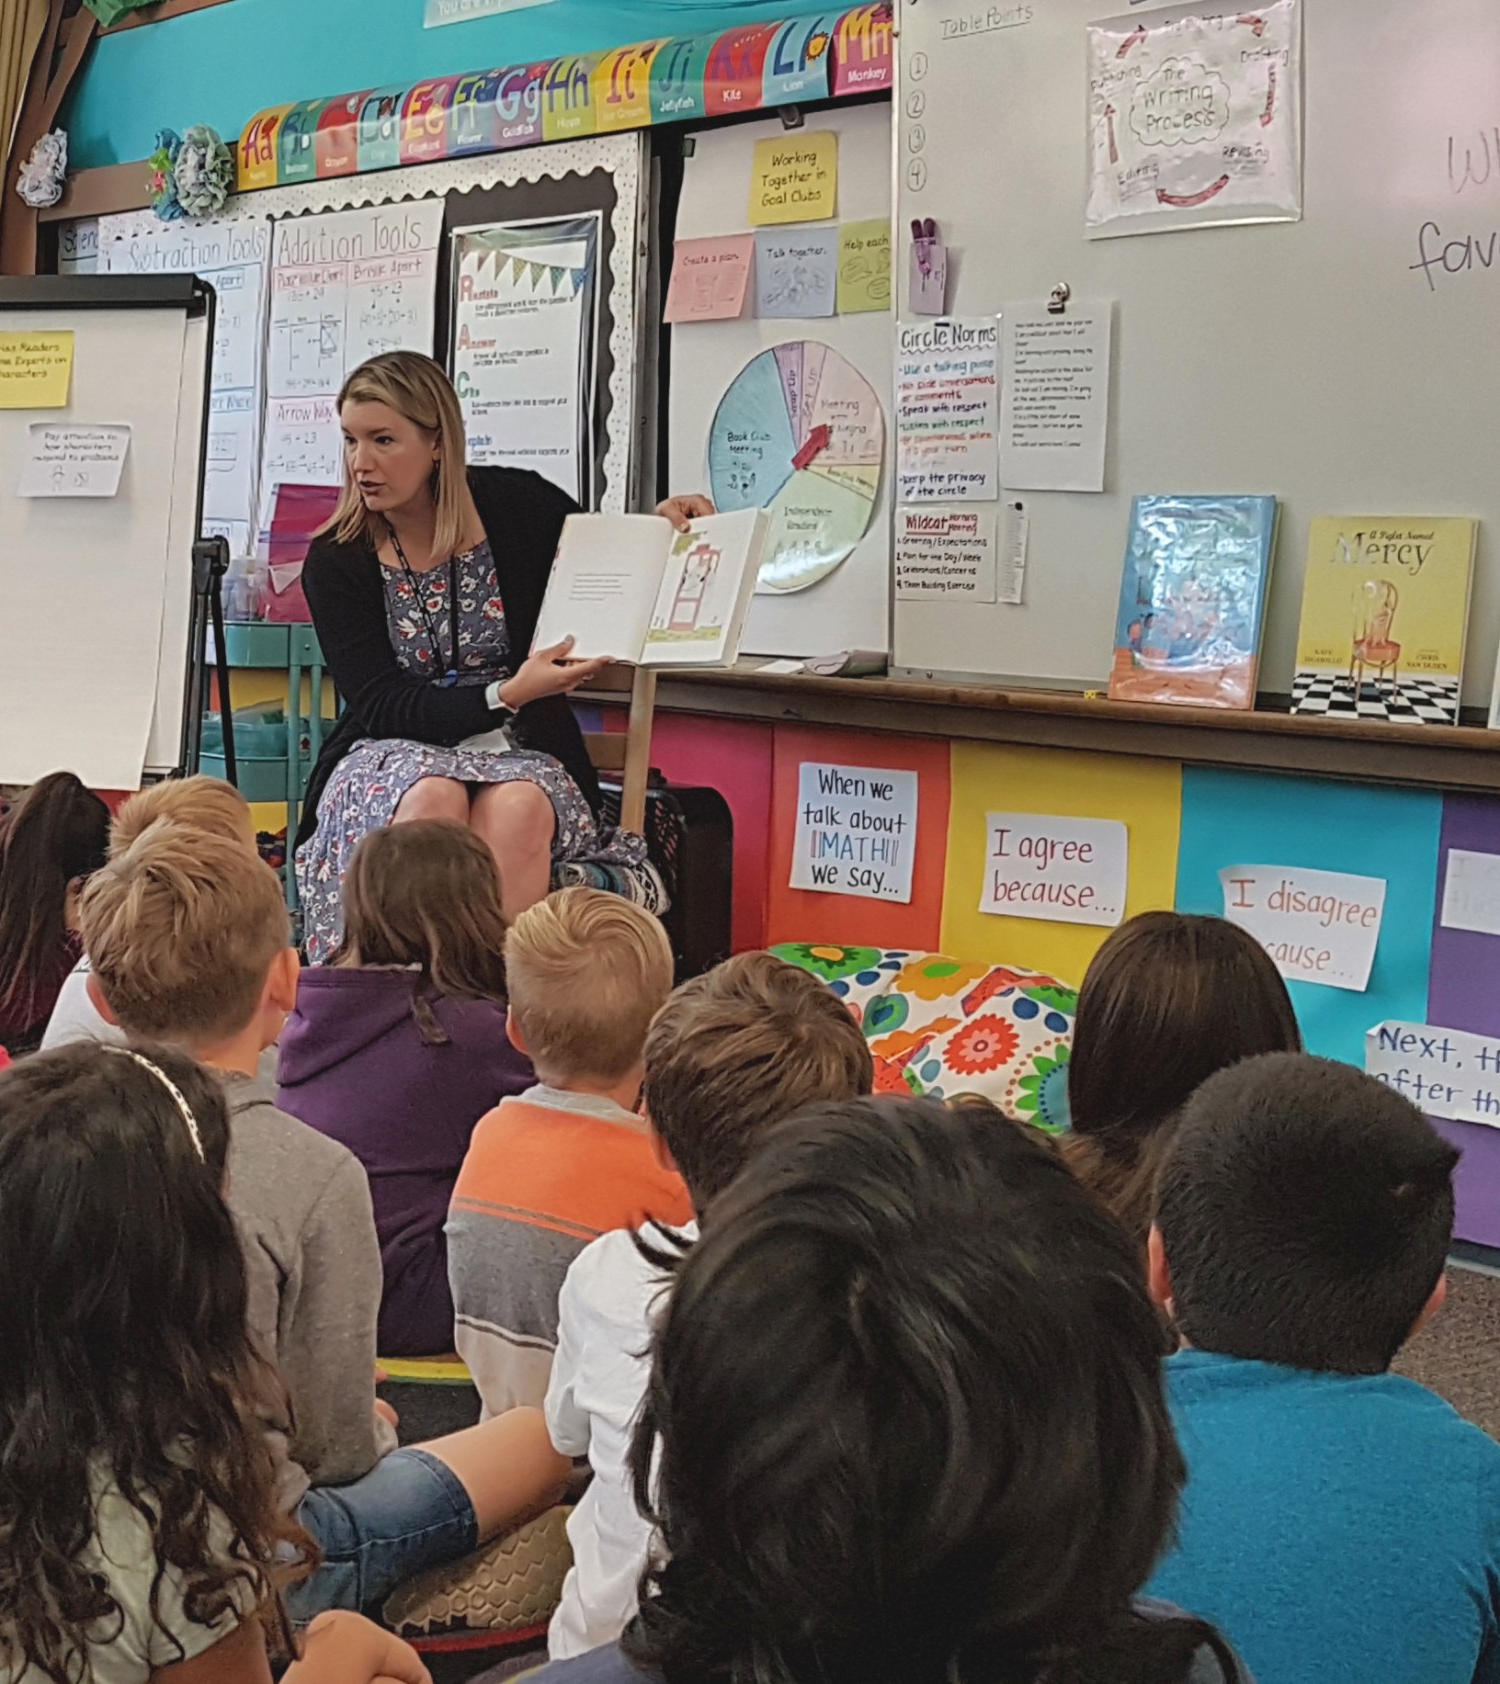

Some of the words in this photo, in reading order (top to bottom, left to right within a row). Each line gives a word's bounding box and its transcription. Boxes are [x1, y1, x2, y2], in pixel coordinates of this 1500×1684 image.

[940, 15, 982, 36] Table
[545, 58, 590, 113] Hh
[847, 67, 887, 84] Monkey
[495, 67, 543, 123] Gg
[772, 150, 817, 167] Working
[762, 169, 813, 190] Together
[816, 166, 827, 180] in
[762, 191, 787, 207] Goal
[791, 187, 822, 202] Clubs
[278, 225, 363, 266] Addition
[371, 215, 422, 253] Tools
[843, 239, 864, 251] Help
[866, 236, 889, 249] each
[1409, 221, 1500, 292] fav
[901, 327, 948, 349] Circle
[952, 323, 997, 345] Norms
[277, 403, 311, 422] Arrow
[952, 400, 987, 413] respect
[937, 485, 967, 496] circle
[905, 514, 949, 530] Wildcat
[1329, 531, 1436, 576] Mercy
[818, 768, 866, 797] When
[869, 782, 894, 801] we
[803, 802, 843, 826] talk
[849, 809, 908, 834] about
[992, 828, 1012, 857] I
[1018, 835, 1095, 871] agree
[811, 863, 839, 885] we
[847, 866, 899, 894] say...
[993, 869, 1116, 914] because...
[1229, 878, 1256, 908] I
[1267, 880, 1378, 928] disagree
[1378, 1026, 1463, 1069] Next,
